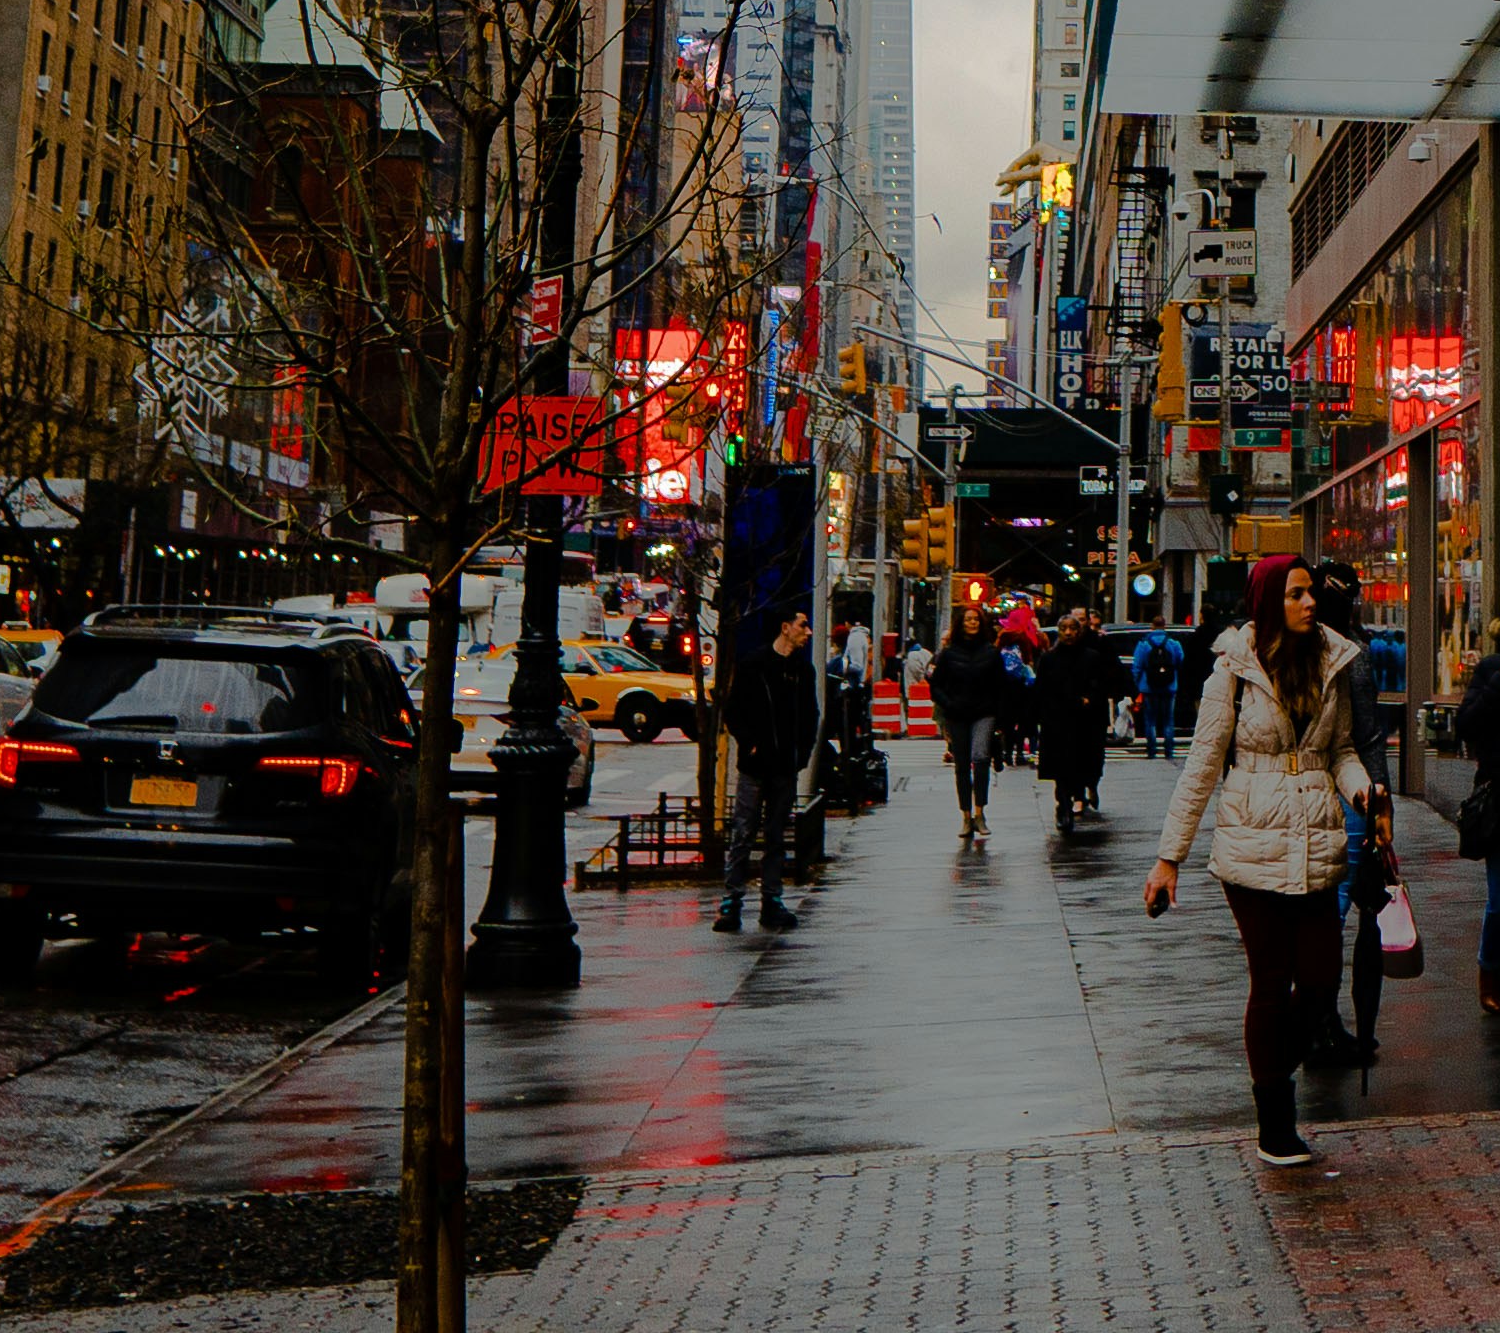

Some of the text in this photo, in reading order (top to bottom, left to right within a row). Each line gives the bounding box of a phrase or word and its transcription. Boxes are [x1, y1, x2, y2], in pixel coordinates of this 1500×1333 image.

[1225, 240, 1253, 250] TRUCK
[1225, 256, 1253, 266] ROUTE
[1060, 330, 1082, 350] ELK
[1210, 337, 1278, 353] RETAIL
[1195, 387, 1217, 397] ONE
[499, 412, 587, 441] RAISE
[1246, 431, 1255, 445] 9
[501, 450, 581, 478] PW
[1086, 550, 1142, 566] PIZA
